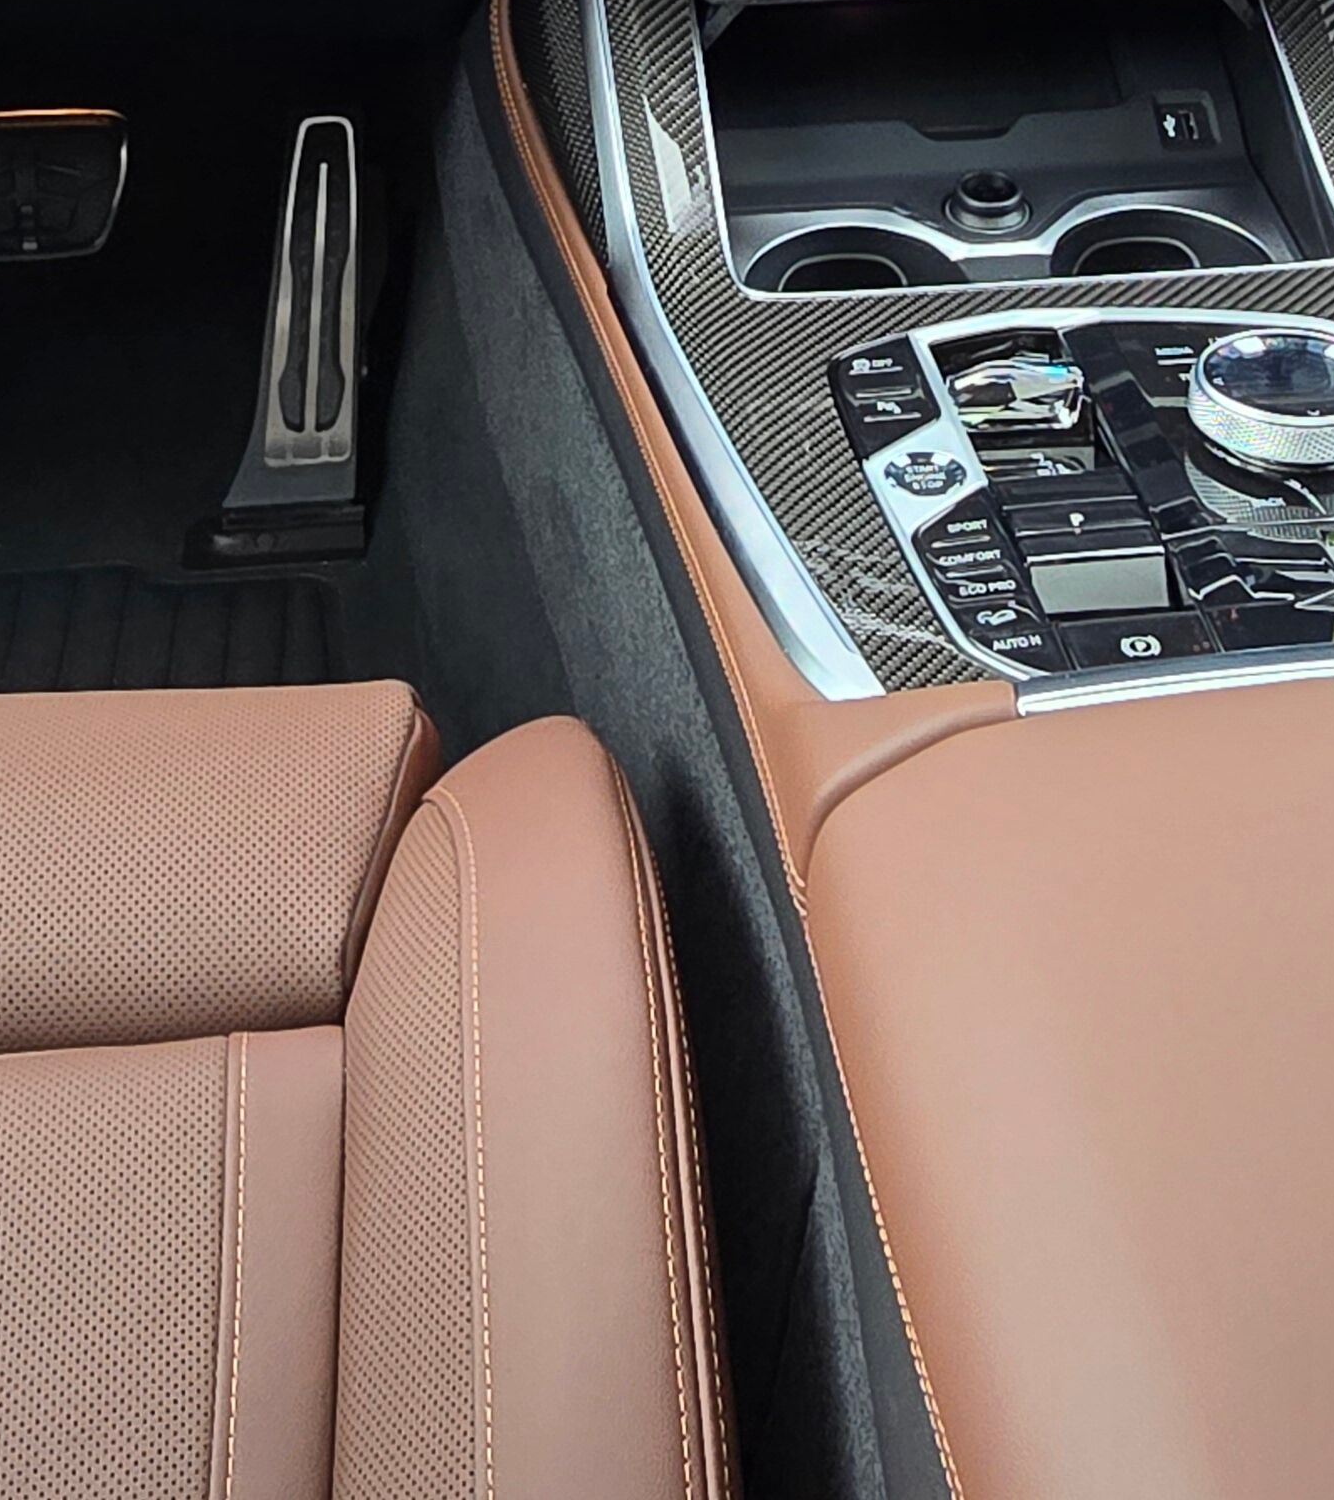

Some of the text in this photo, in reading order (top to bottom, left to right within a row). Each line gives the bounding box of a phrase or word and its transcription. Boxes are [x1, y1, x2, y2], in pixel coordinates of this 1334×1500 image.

[947, 519, 987, 534] SPORT
[939, 549, 1001, 564] COMFORT
[959, 580, 1017, 597] ECO PRO
[992, 636, 1029, 651] AUTO
